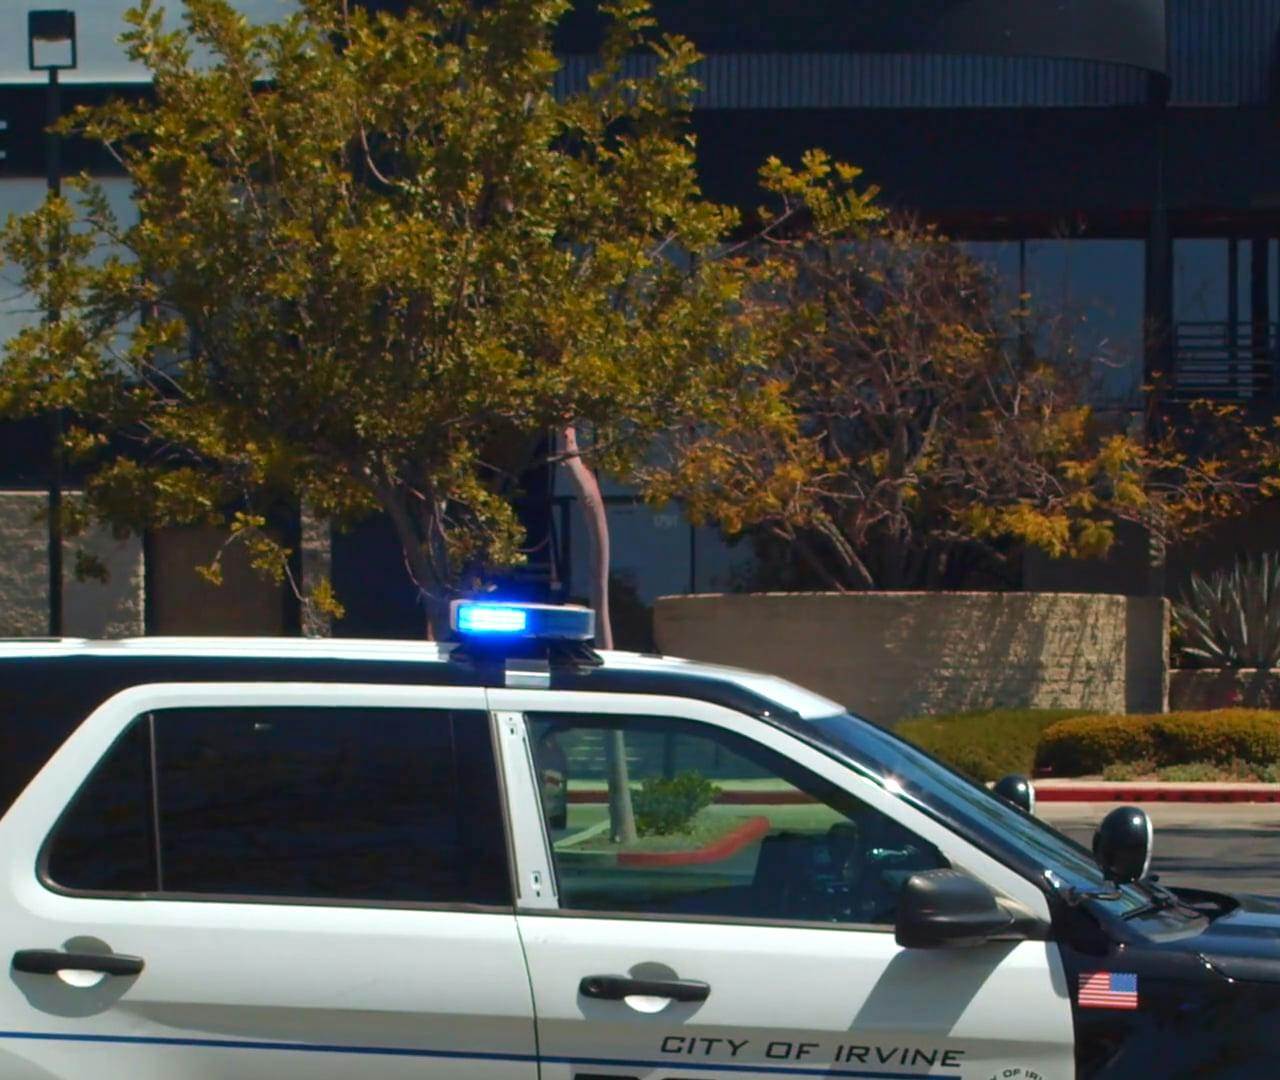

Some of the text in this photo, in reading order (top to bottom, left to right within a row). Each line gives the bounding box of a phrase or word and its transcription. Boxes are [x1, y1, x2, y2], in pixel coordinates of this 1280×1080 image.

[660, 1035, 966, 1068] CITY OF IRVINE
[1002, 1068, 1021, 1078] OF
